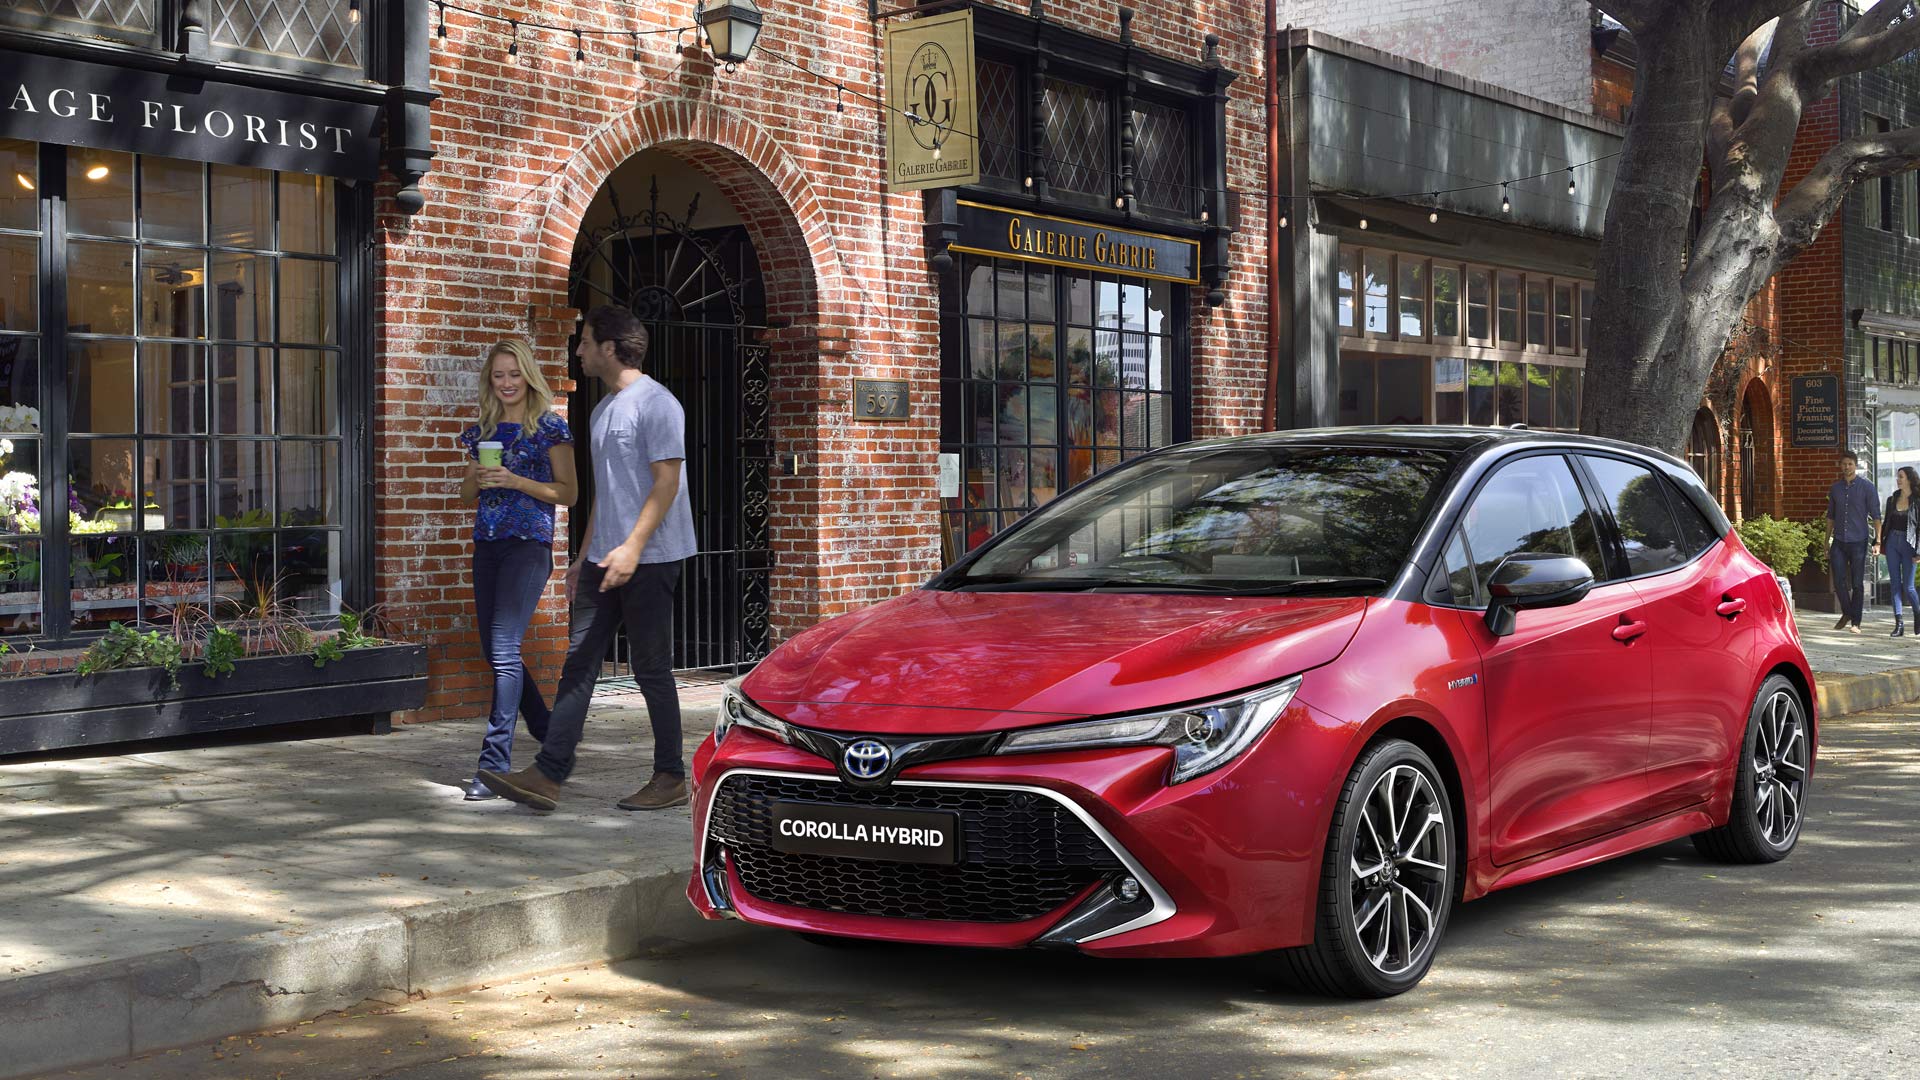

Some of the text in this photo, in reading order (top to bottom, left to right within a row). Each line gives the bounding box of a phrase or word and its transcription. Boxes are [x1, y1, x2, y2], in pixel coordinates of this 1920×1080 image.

[8, 83, 353, 154] AGE FLORIST
[898, 158, 968, 177] GALERIE GABRIE
[1009, 217, 1157, 270] GALERIE GABRIE
[1805, 379, 1823, 388] 603
[866, 394, 899, 416] 597
[1804, 396, 1825, 404] Fine
[1799, 405, 1831, 413] Picture
[1796, 413, 1835, 423] Framing
[1796, 434, 1836, 442] Accessories
[1447, 676, 1474, 690] HYBRID
[779, 819, 944, 847] COROLLA HYBRID
